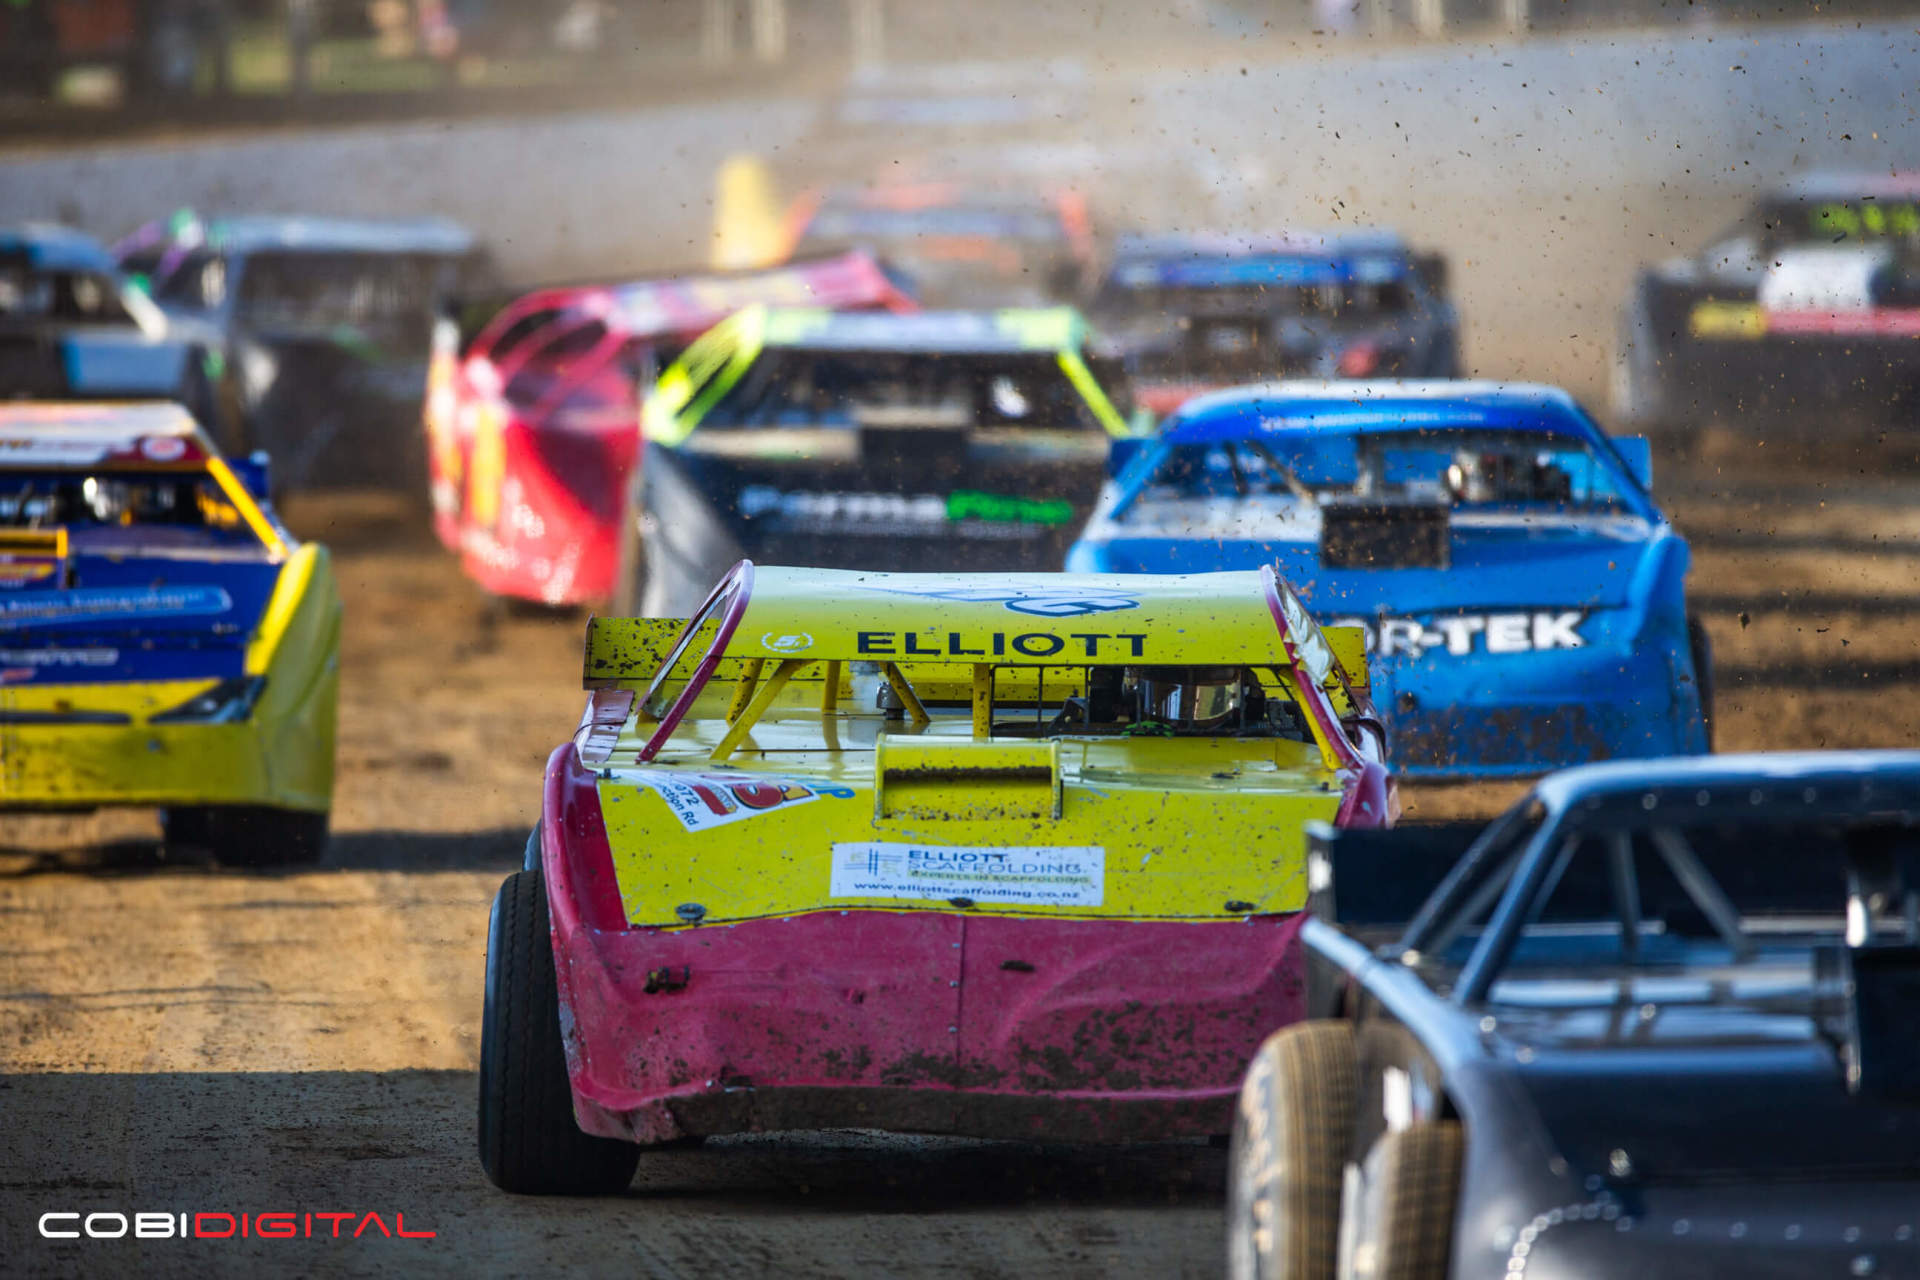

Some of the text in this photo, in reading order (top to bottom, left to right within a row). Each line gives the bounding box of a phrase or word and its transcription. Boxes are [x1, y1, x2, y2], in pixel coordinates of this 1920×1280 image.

[1333, 612, 1585, 657] R-TEK
[857, 631, 1148, 657] ELLIOTT
[908, 850, 1008, 863] ELLIOTT
[908, 860, 1081, 874] SCAFFOLDING
[854, 881, 1080, 899] www.elliottscaffolding.co.nz
